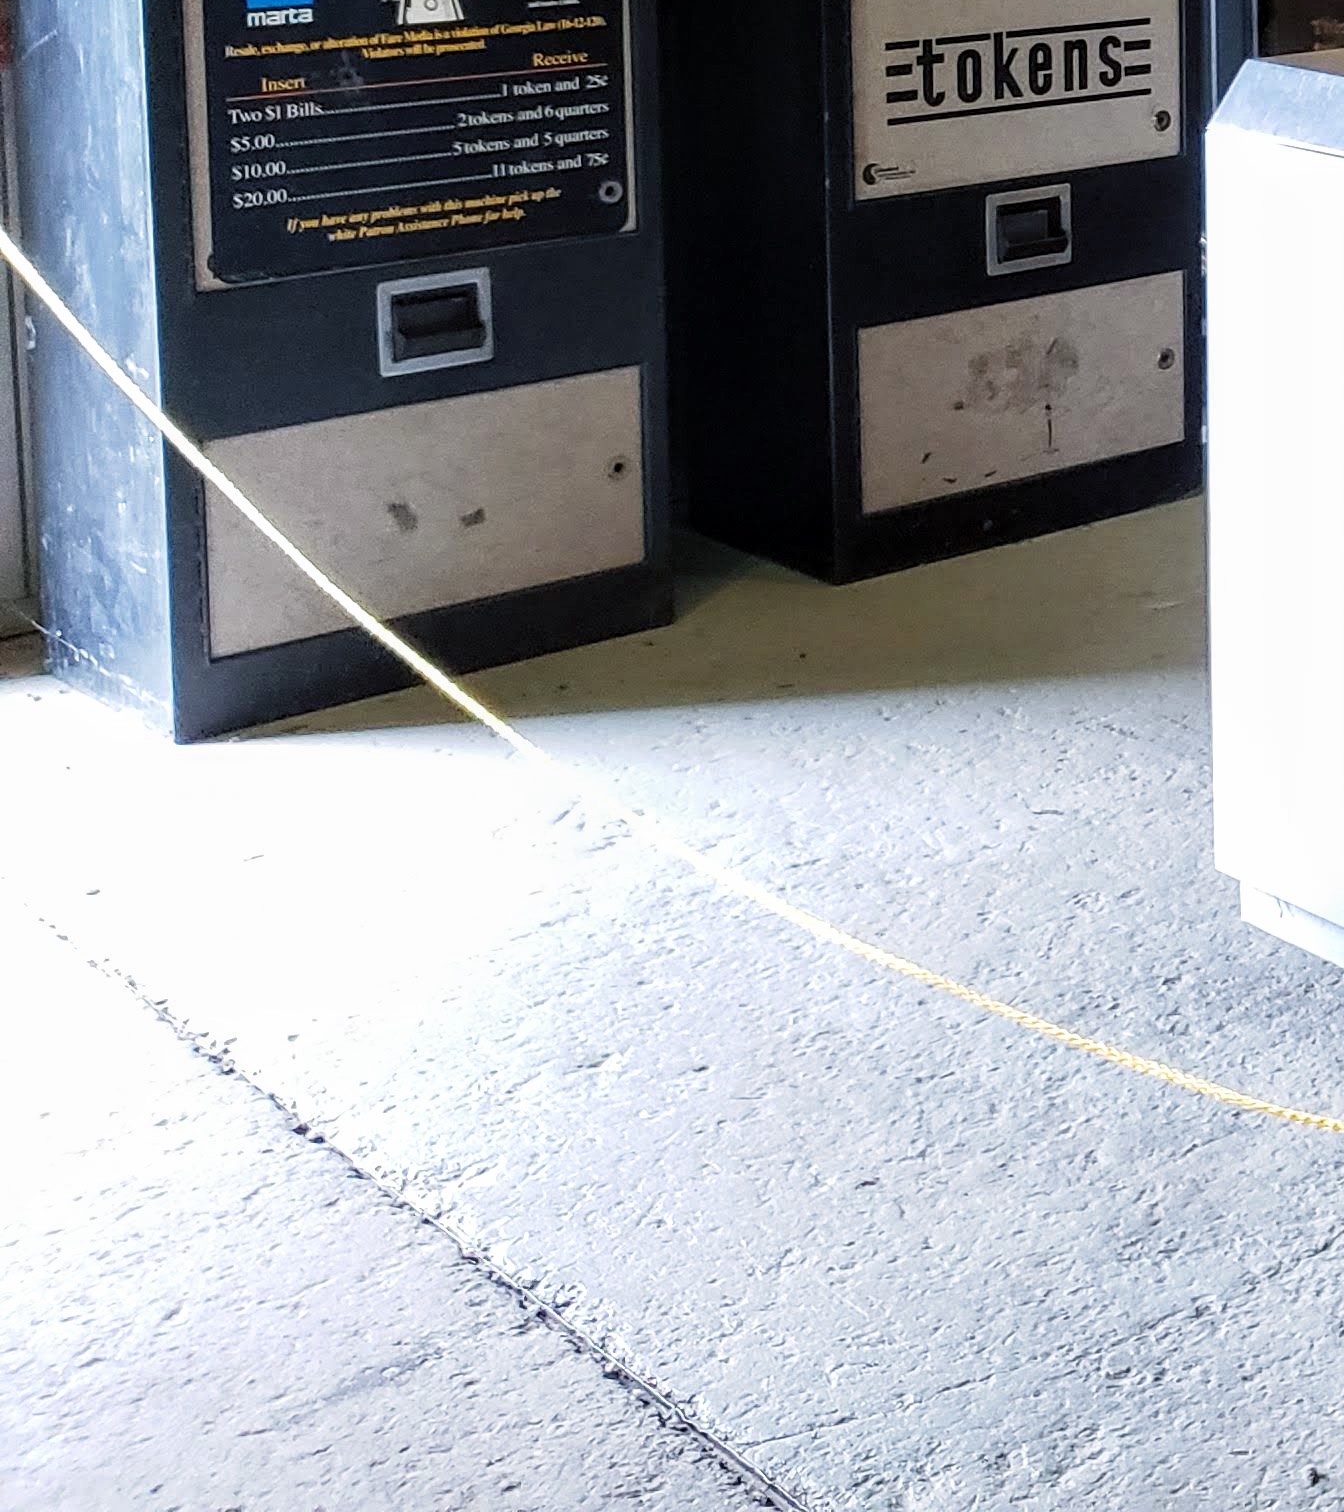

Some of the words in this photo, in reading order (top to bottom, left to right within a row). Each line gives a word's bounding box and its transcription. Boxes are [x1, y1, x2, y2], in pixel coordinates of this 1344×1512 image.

[247, 8, 314, 27] marta
[533, 51, 589, 67] Receive
[916, 31, 1122, 107] tokens
[261, 77, 306, 92] Insert
[228, 109, 262, 125] Two
[513, 81, 551, 96] token
[555, 76, 580, 92] and
[468, 111, 514, 126] tokens
[518, 106, 542, 122] and
[545, 105, 553, 118] 6
[555, 103, 610, 121] quarters
[464, 139, 510, 155] tokens
[514, 133, 539, 149] and
[544, 132, 552, 146] 5
[555, 129, 609, 148] quarters
[509, 161, 553, 176] tokens
[557, 155, 582, 170] and
